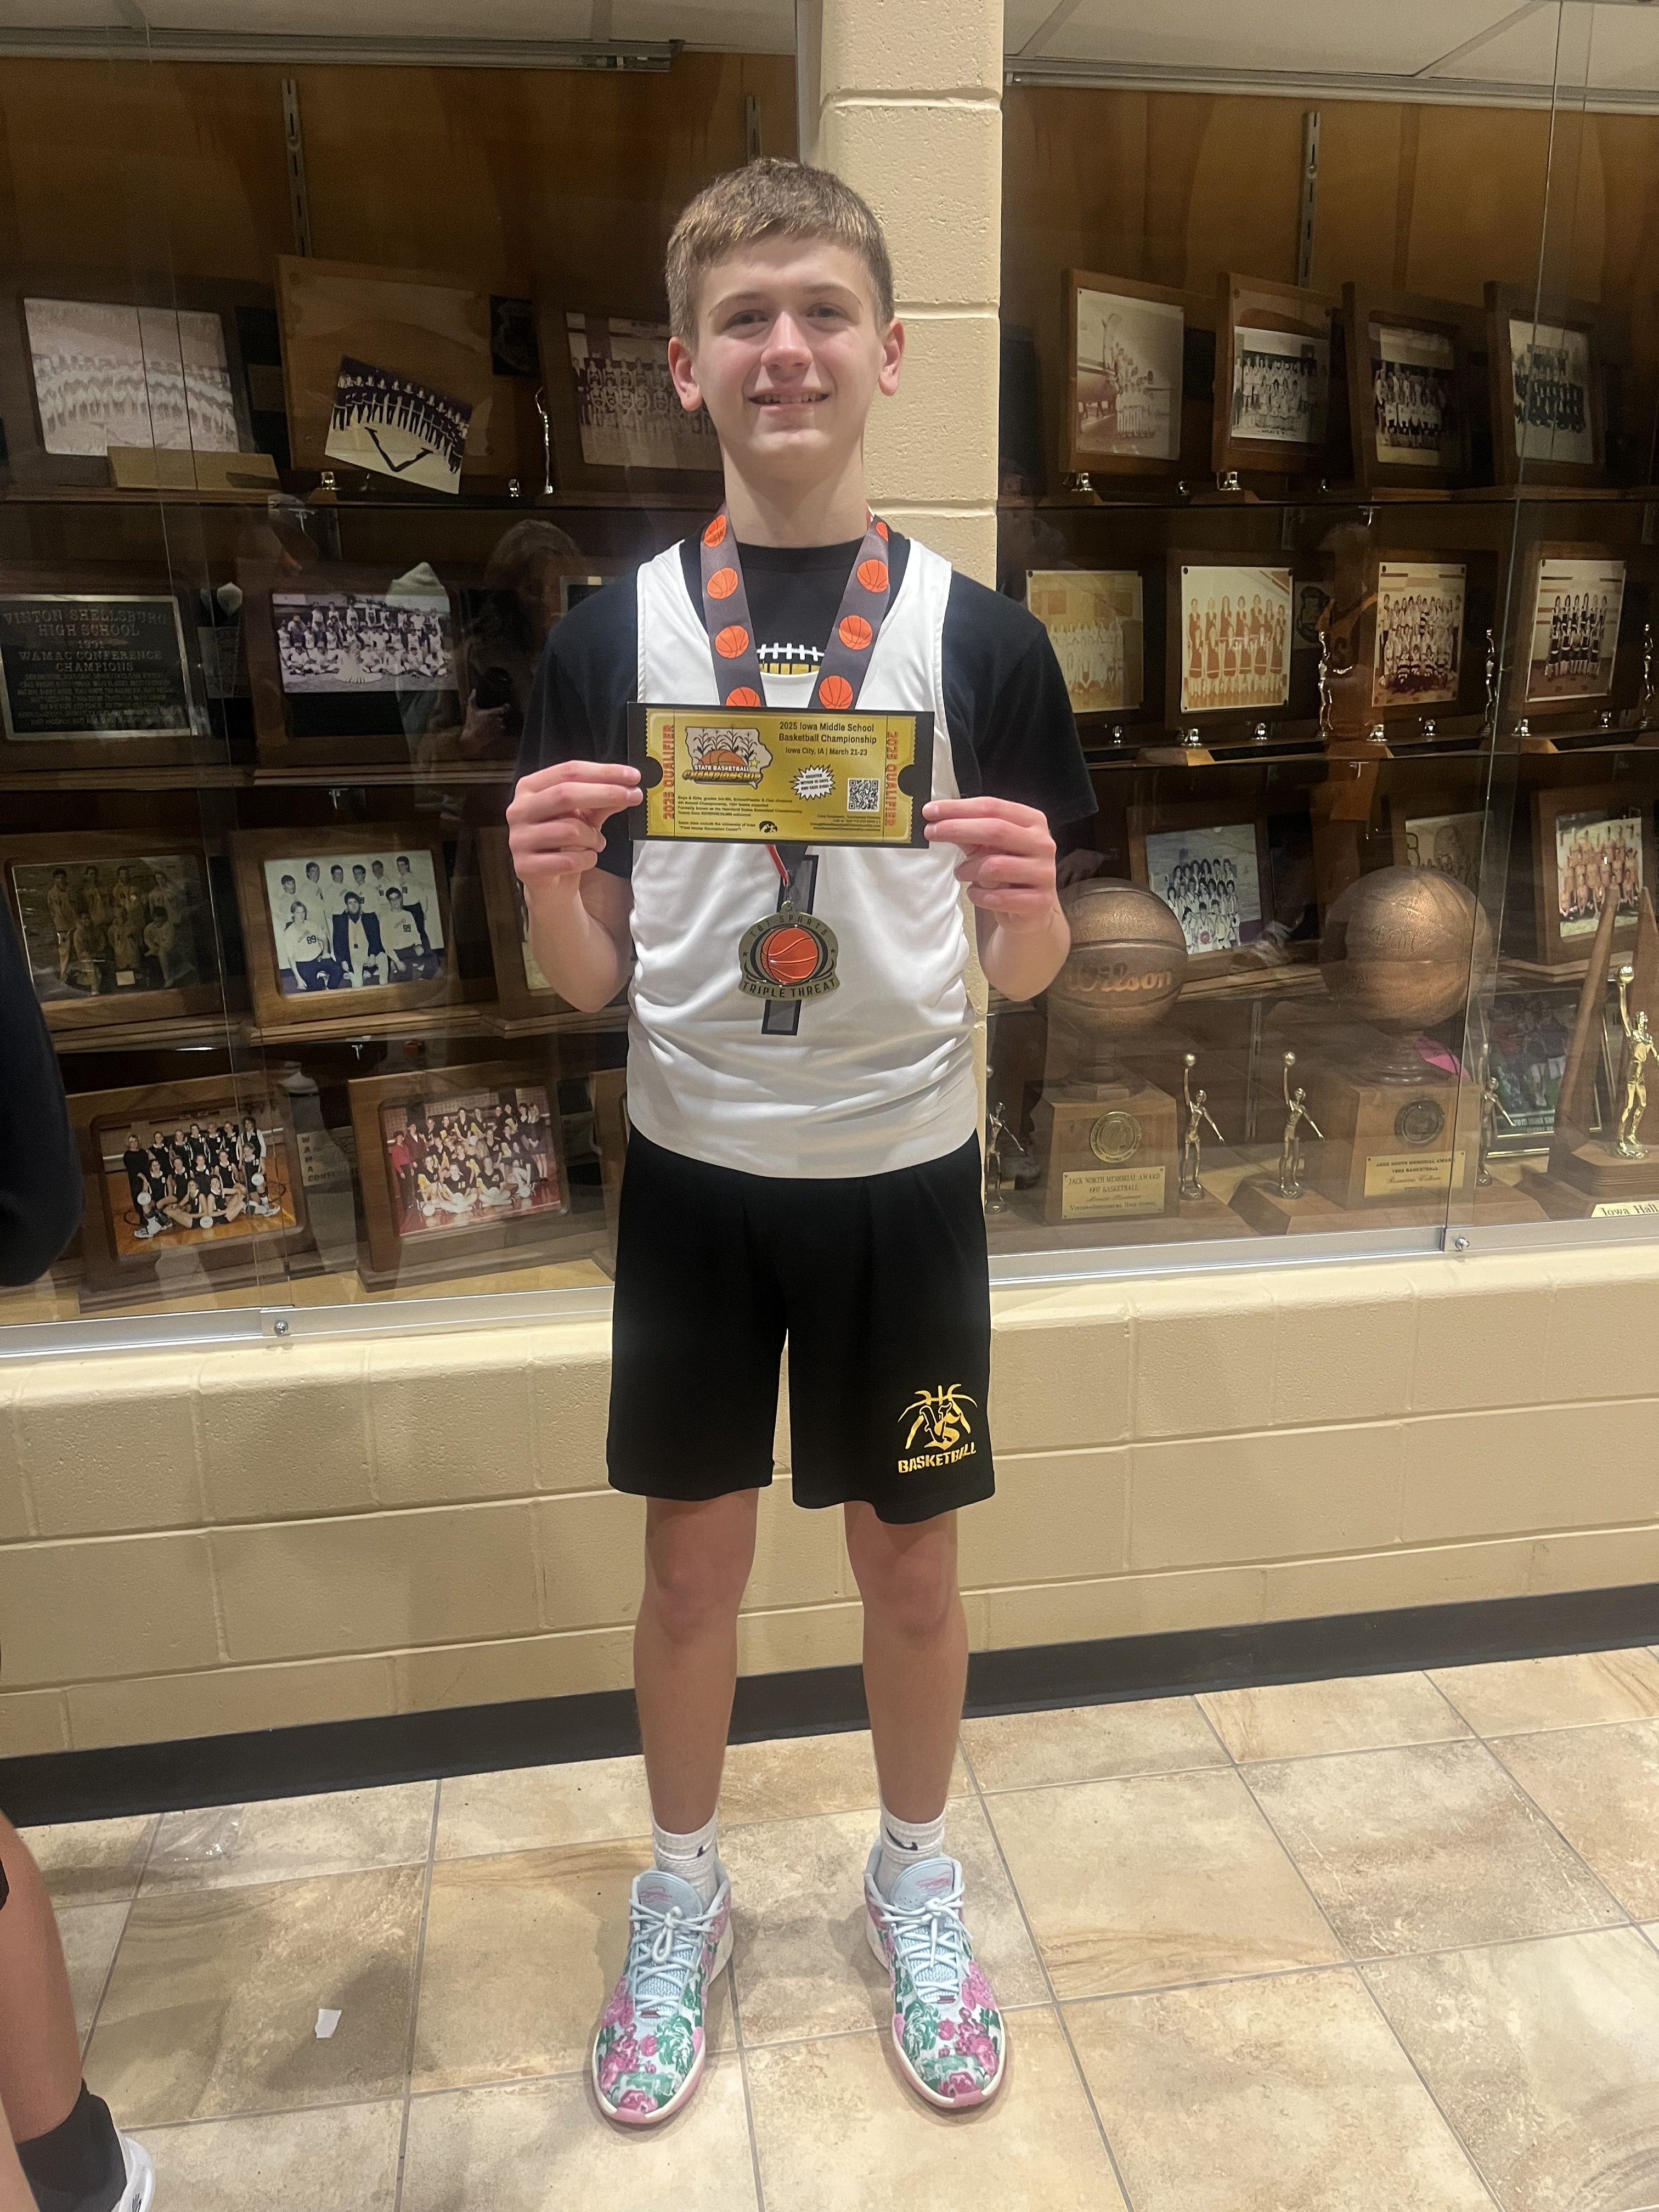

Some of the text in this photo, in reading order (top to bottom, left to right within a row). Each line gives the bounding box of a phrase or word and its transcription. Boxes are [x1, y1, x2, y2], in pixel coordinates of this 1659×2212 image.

[37, 624, 140, 636] HIGH SCHOOL
[76, 651, 162, 661] CONFERENCE
[56, 662, 134, 673] CHAMPIONS
[780, 721, 797, 730] 2025
[820, 723, 845, 731] Middle
[847, 724, 874, 732] School
[779, 733, 877, 744] Basketball Championship
[663, 725, 674, 819] 2025 QUALIFIER
[682, 769, 761, 781] CHAMPIONSHIP
[885, 731, 898, 826] 2025 QUALIFIER
[306, 935, 317, 945] 89
[742, 979, 836, 998] TRIPLE THREAT
[1085, 1176, 1105, 1184] NORTH
[1106, 1174, 1137, 1183] MEMORIAL
[1139, 1172, 1161, 1180] AWARD
[1103, 1183, 1139, 1193] BASKETBALL
[1600, 1204, 1658, 1216] Iowa Hall
[898, 1441, 977, 1474] BASKETBALL
